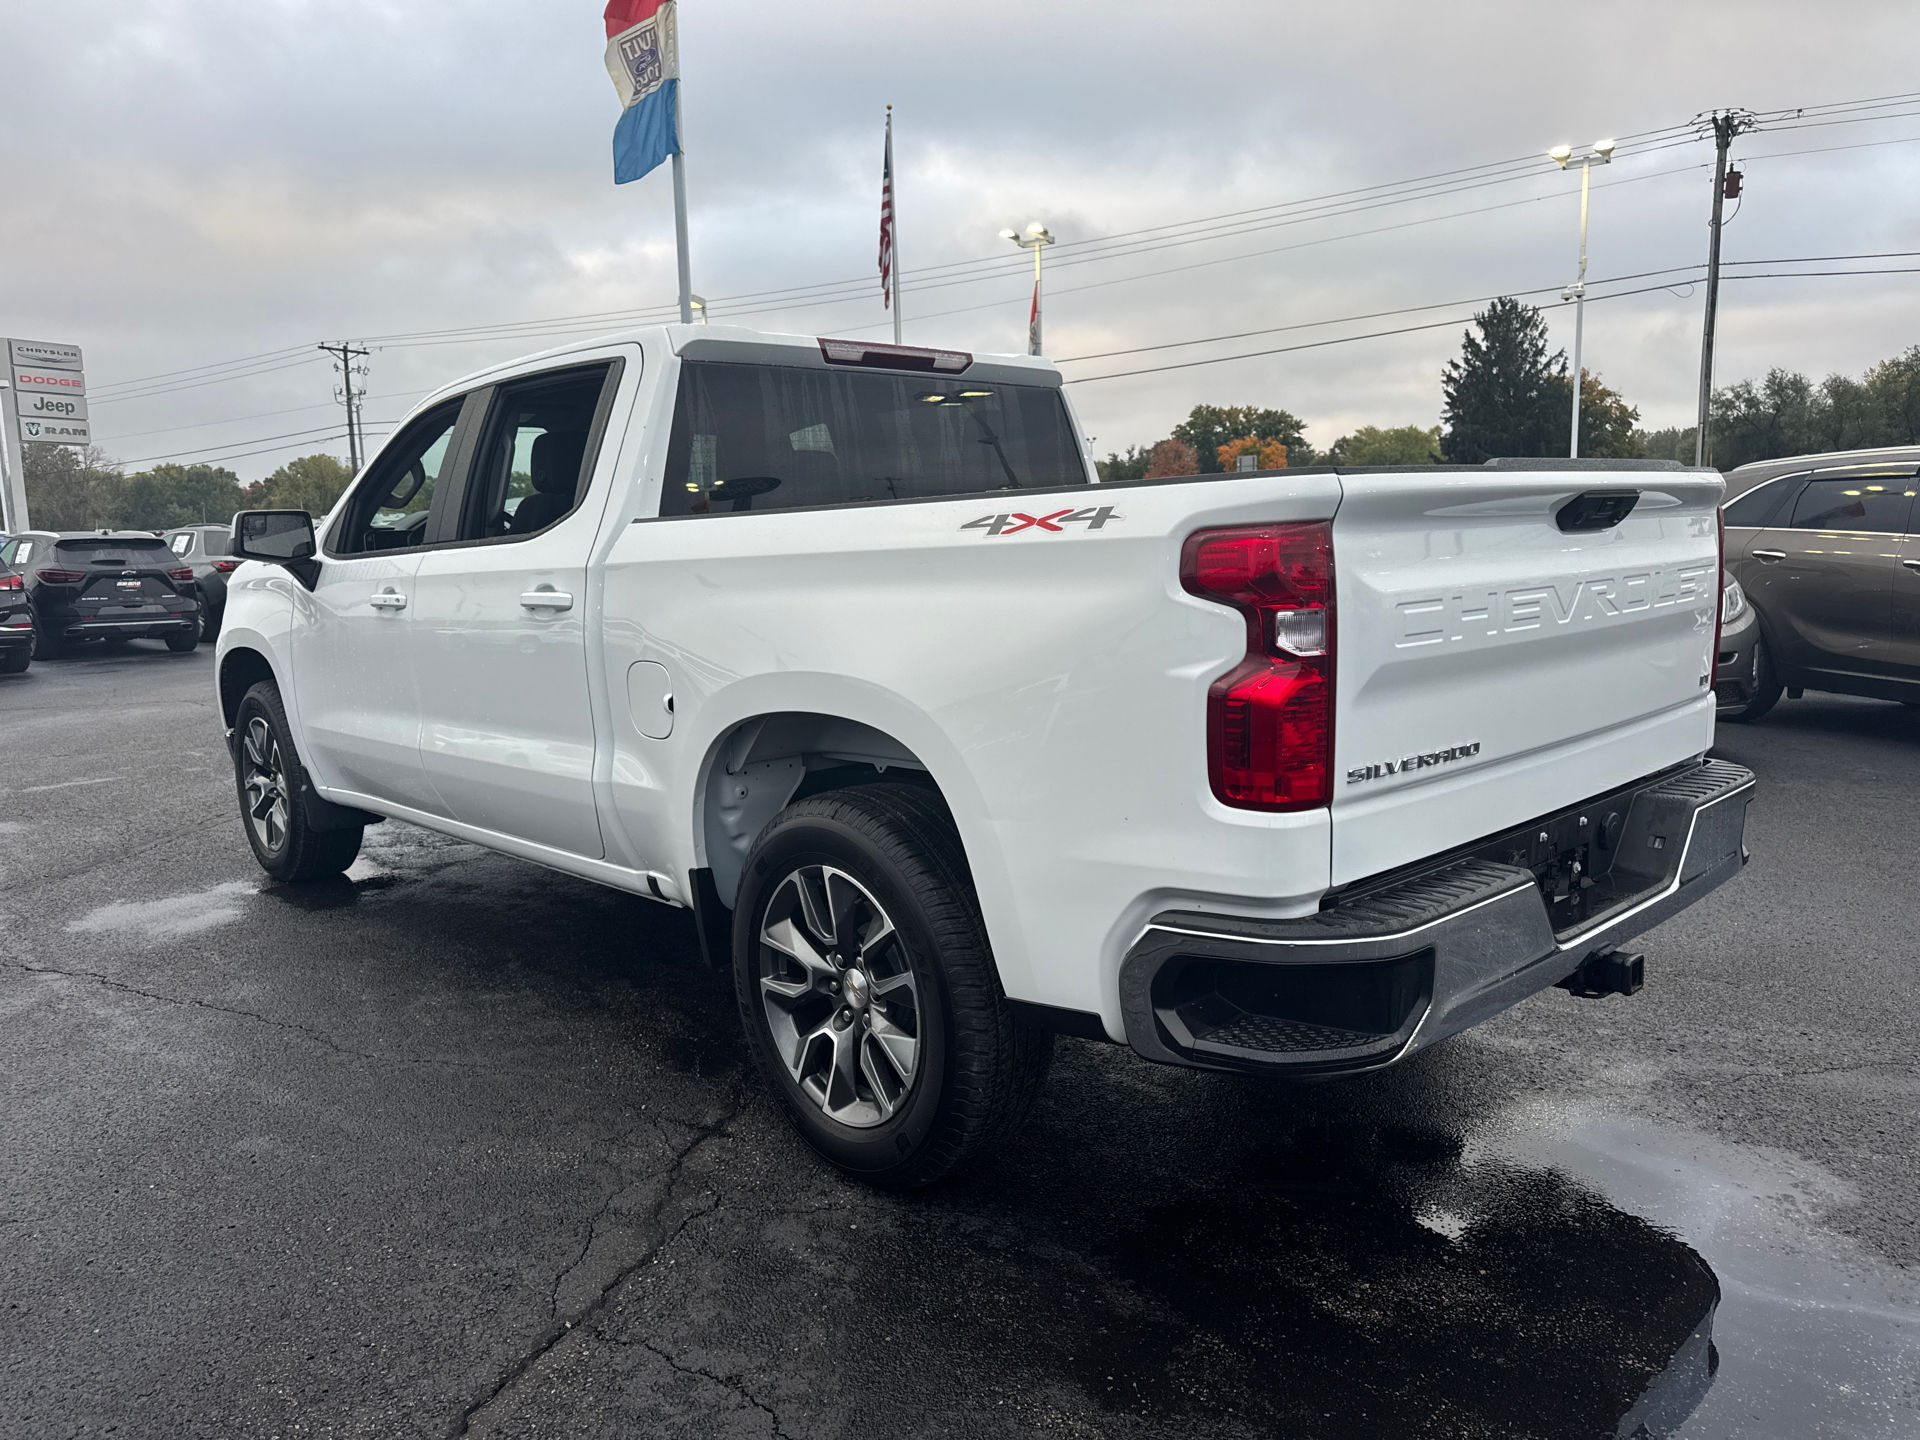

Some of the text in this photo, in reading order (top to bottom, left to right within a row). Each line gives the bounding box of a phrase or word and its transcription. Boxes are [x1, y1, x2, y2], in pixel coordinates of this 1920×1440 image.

[17, 346, 78, 358] CHRYSLER
[19, 375, 82, 388] DODGE
[33, 396, 76, 416] Jeep
[44, 426, 87, 437] RAM
[1394, 563, 1715, 648] CHEVROLET
[1346, 741, 1481, 785] SILVERADO
